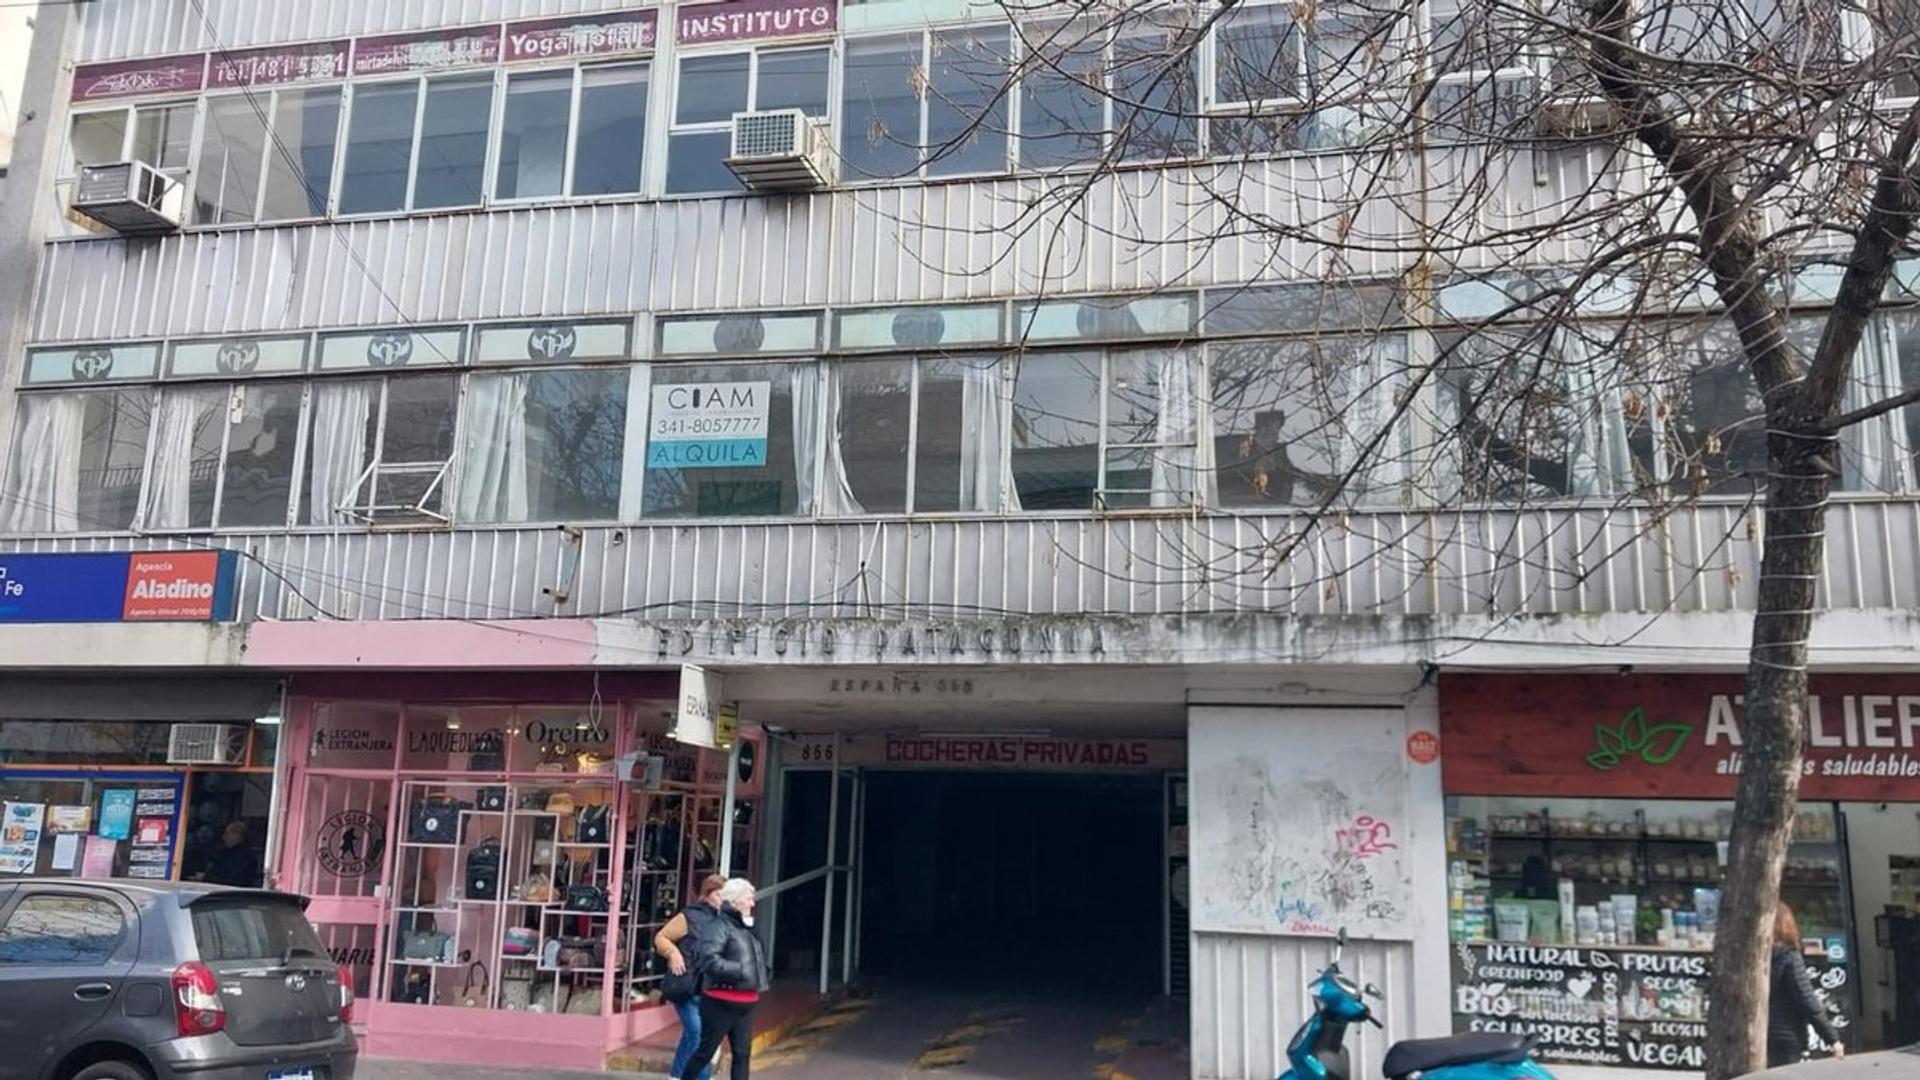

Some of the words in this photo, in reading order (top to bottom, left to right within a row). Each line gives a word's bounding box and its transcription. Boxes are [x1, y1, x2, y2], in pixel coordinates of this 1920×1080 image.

[682, 7, 829, 38] INSTITUTO
[510, 32, 568, 57] Yoga
[255, 57, 290, 79] 481
[668, 387, 754, 410] CIAM
[658, 417, 761, 435] 341-8057777
[654, 443, 758, 463] ALQUILA
[136, 562, 173, 574] Agencia
[5, 580, 24, 597] Fe
[131, 579, 214, 600] Aladino
[830, 675, 922, 694] ESPAÑA
[1704, 694, 1920, 748] ALIER
[328, 729, 370, 740] LEGION
[328, 740, 393, 751] EXTRANJERA
[885, 740, 1017, 763] COCHERAS
[1022, 741, 1150, 766] PRIVADAS
[1486, 944, 1588, 967] NATURAL
[1622, 953, 1706, 976] FRUTAS
[1643, 975, 1698, 996] SECAS
[1650, 1022, 1692, 1038] 100%
